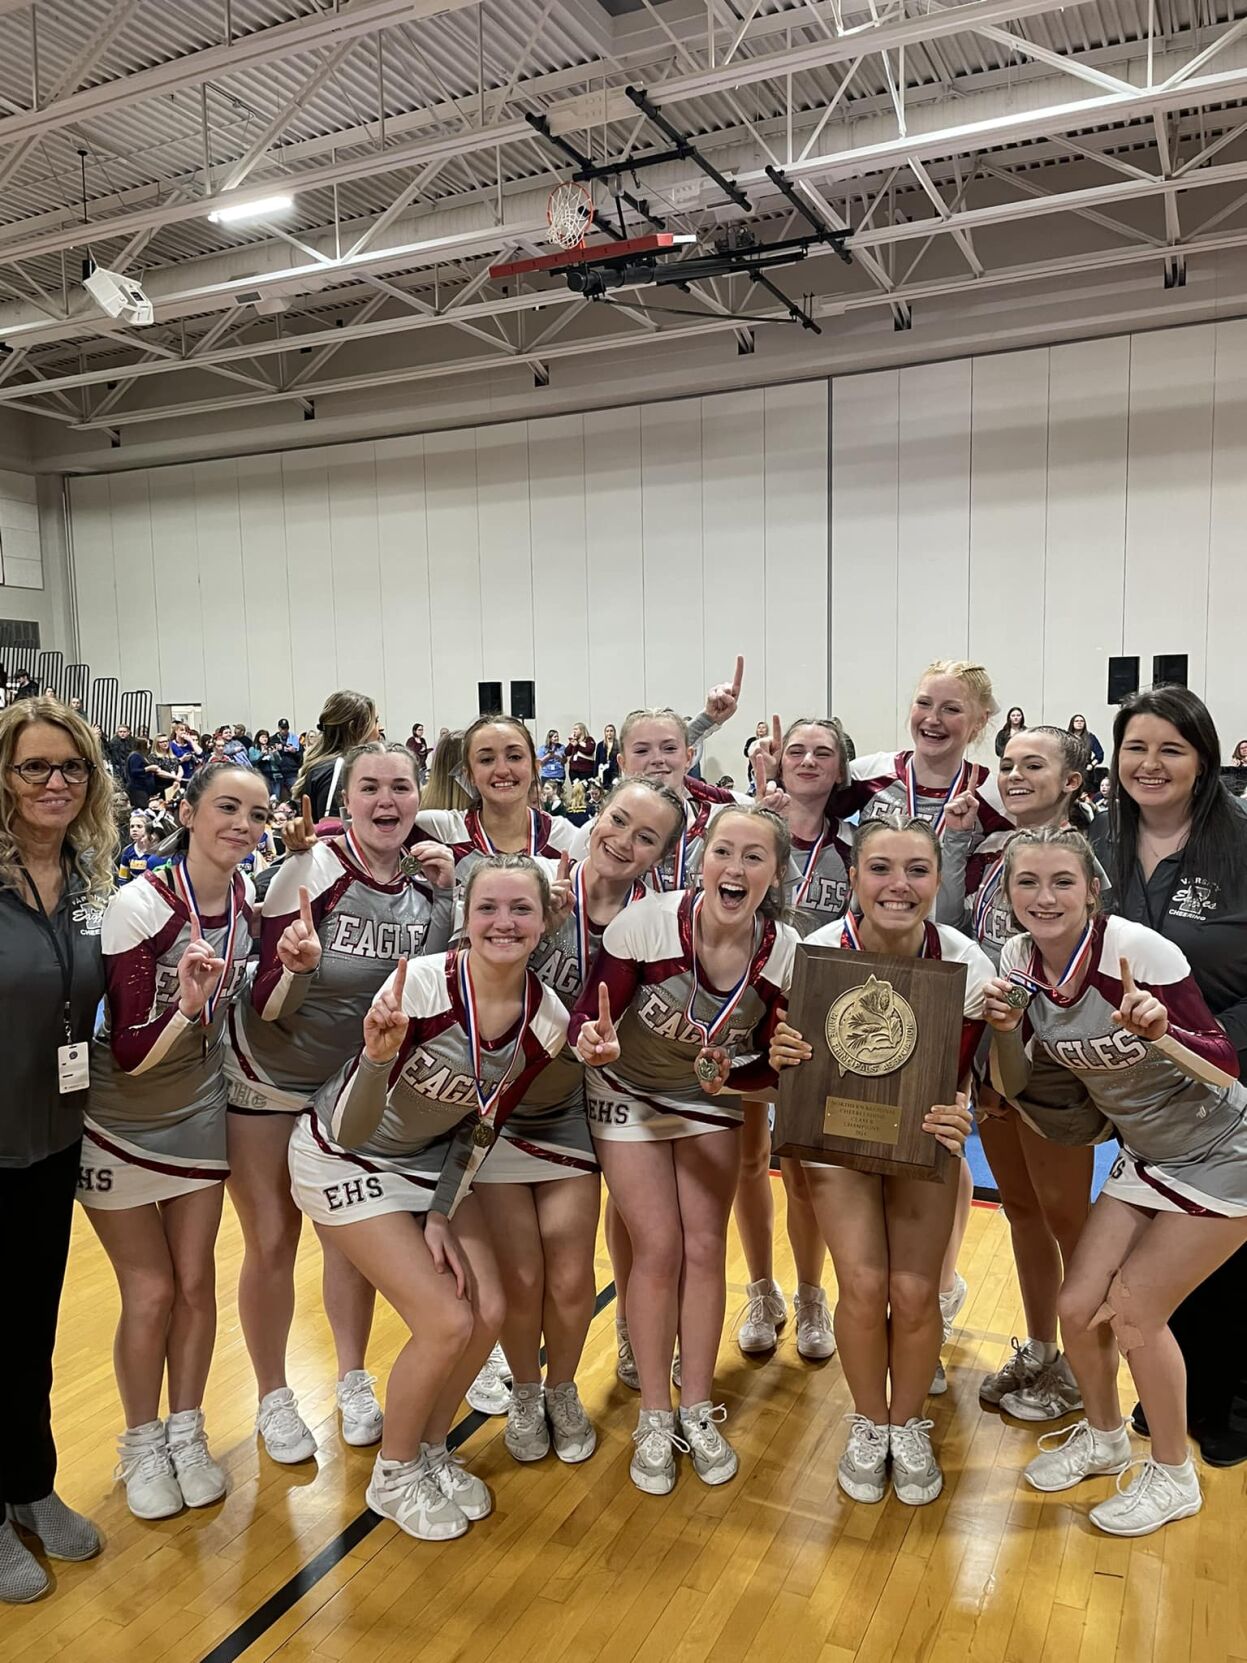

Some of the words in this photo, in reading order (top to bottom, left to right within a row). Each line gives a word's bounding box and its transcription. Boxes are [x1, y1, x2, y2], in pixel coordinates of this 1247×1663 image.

[329, 913, 428, 960] EAGLE
[1042, 1027, 1148, 1071] GLES
[400, 1046, 514, 1107] EAGL
[588, 1100, 630, 1125] EHS
[323, 1176, 384, 1211] EHS
